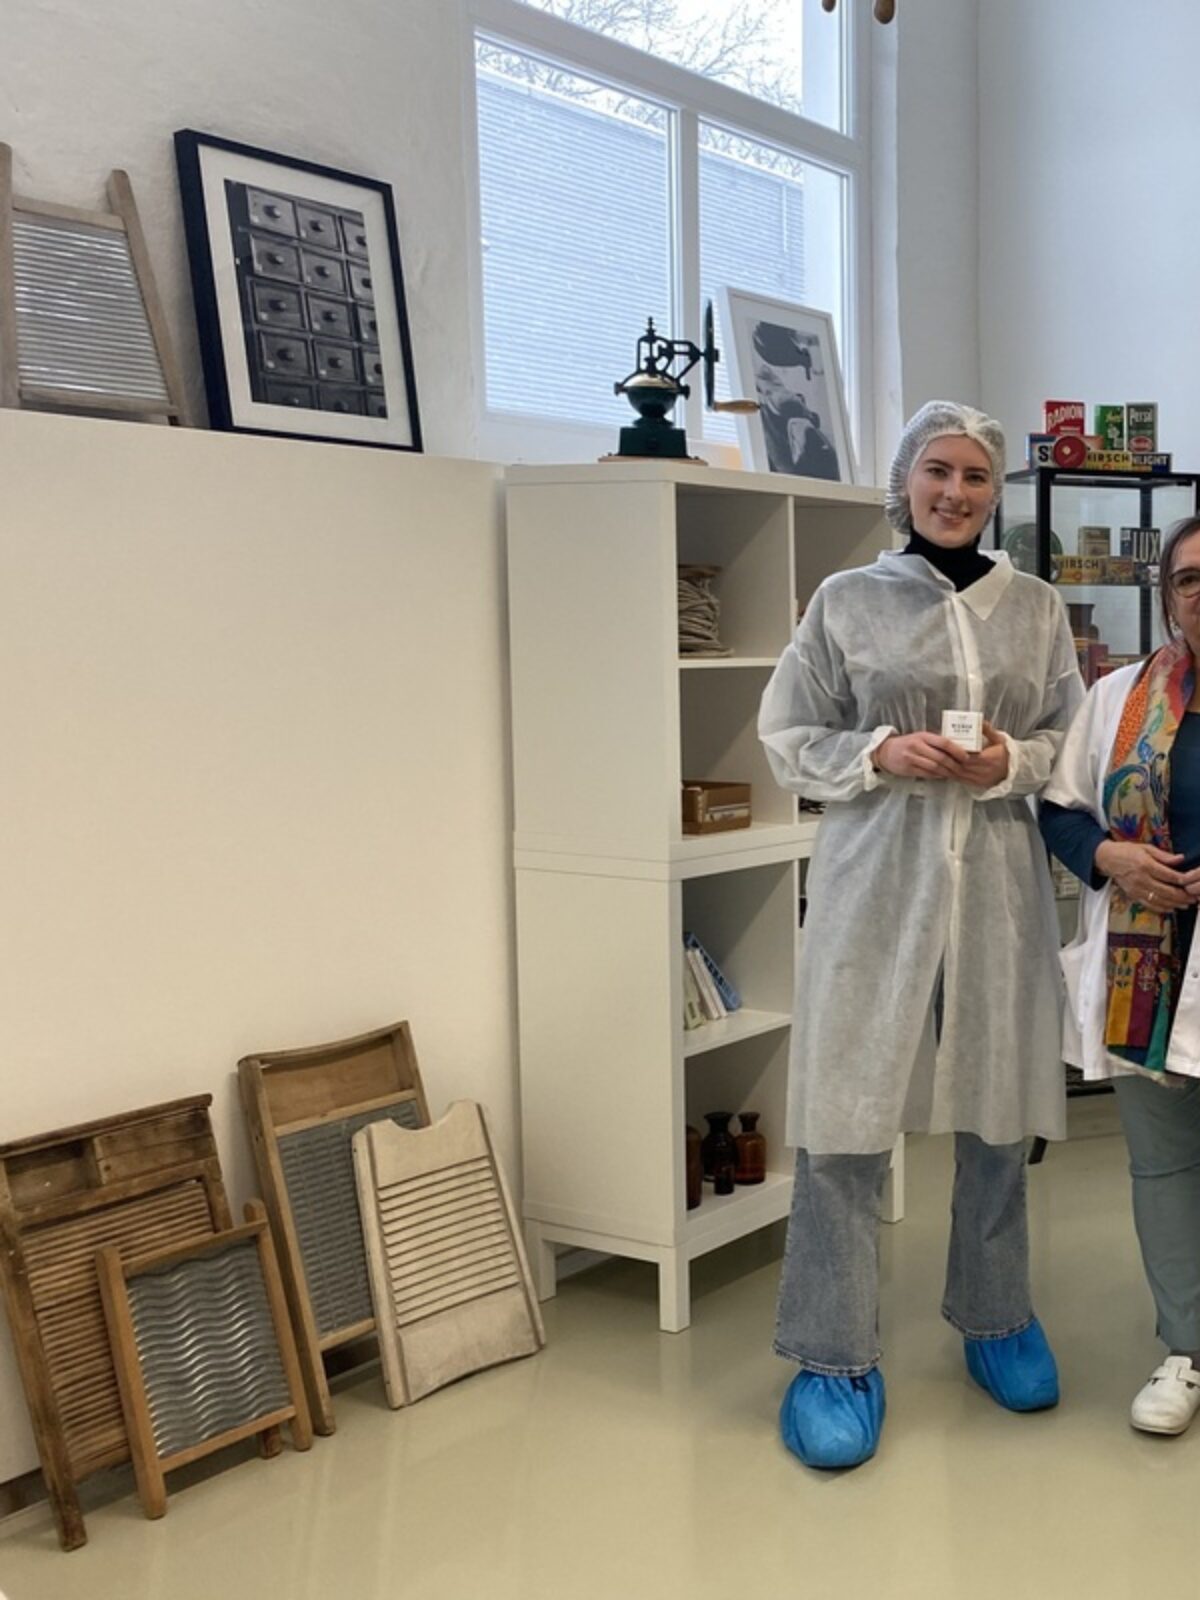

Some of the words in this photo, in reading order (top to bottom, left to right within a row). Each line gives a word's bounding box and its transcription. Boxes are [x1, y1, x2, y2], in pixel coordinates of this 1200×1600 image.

[1047, 404, 1083, 431] RADION
[1129, 407, 1153, 426] Persil
[1133, 531, 1160, 563] LUX
